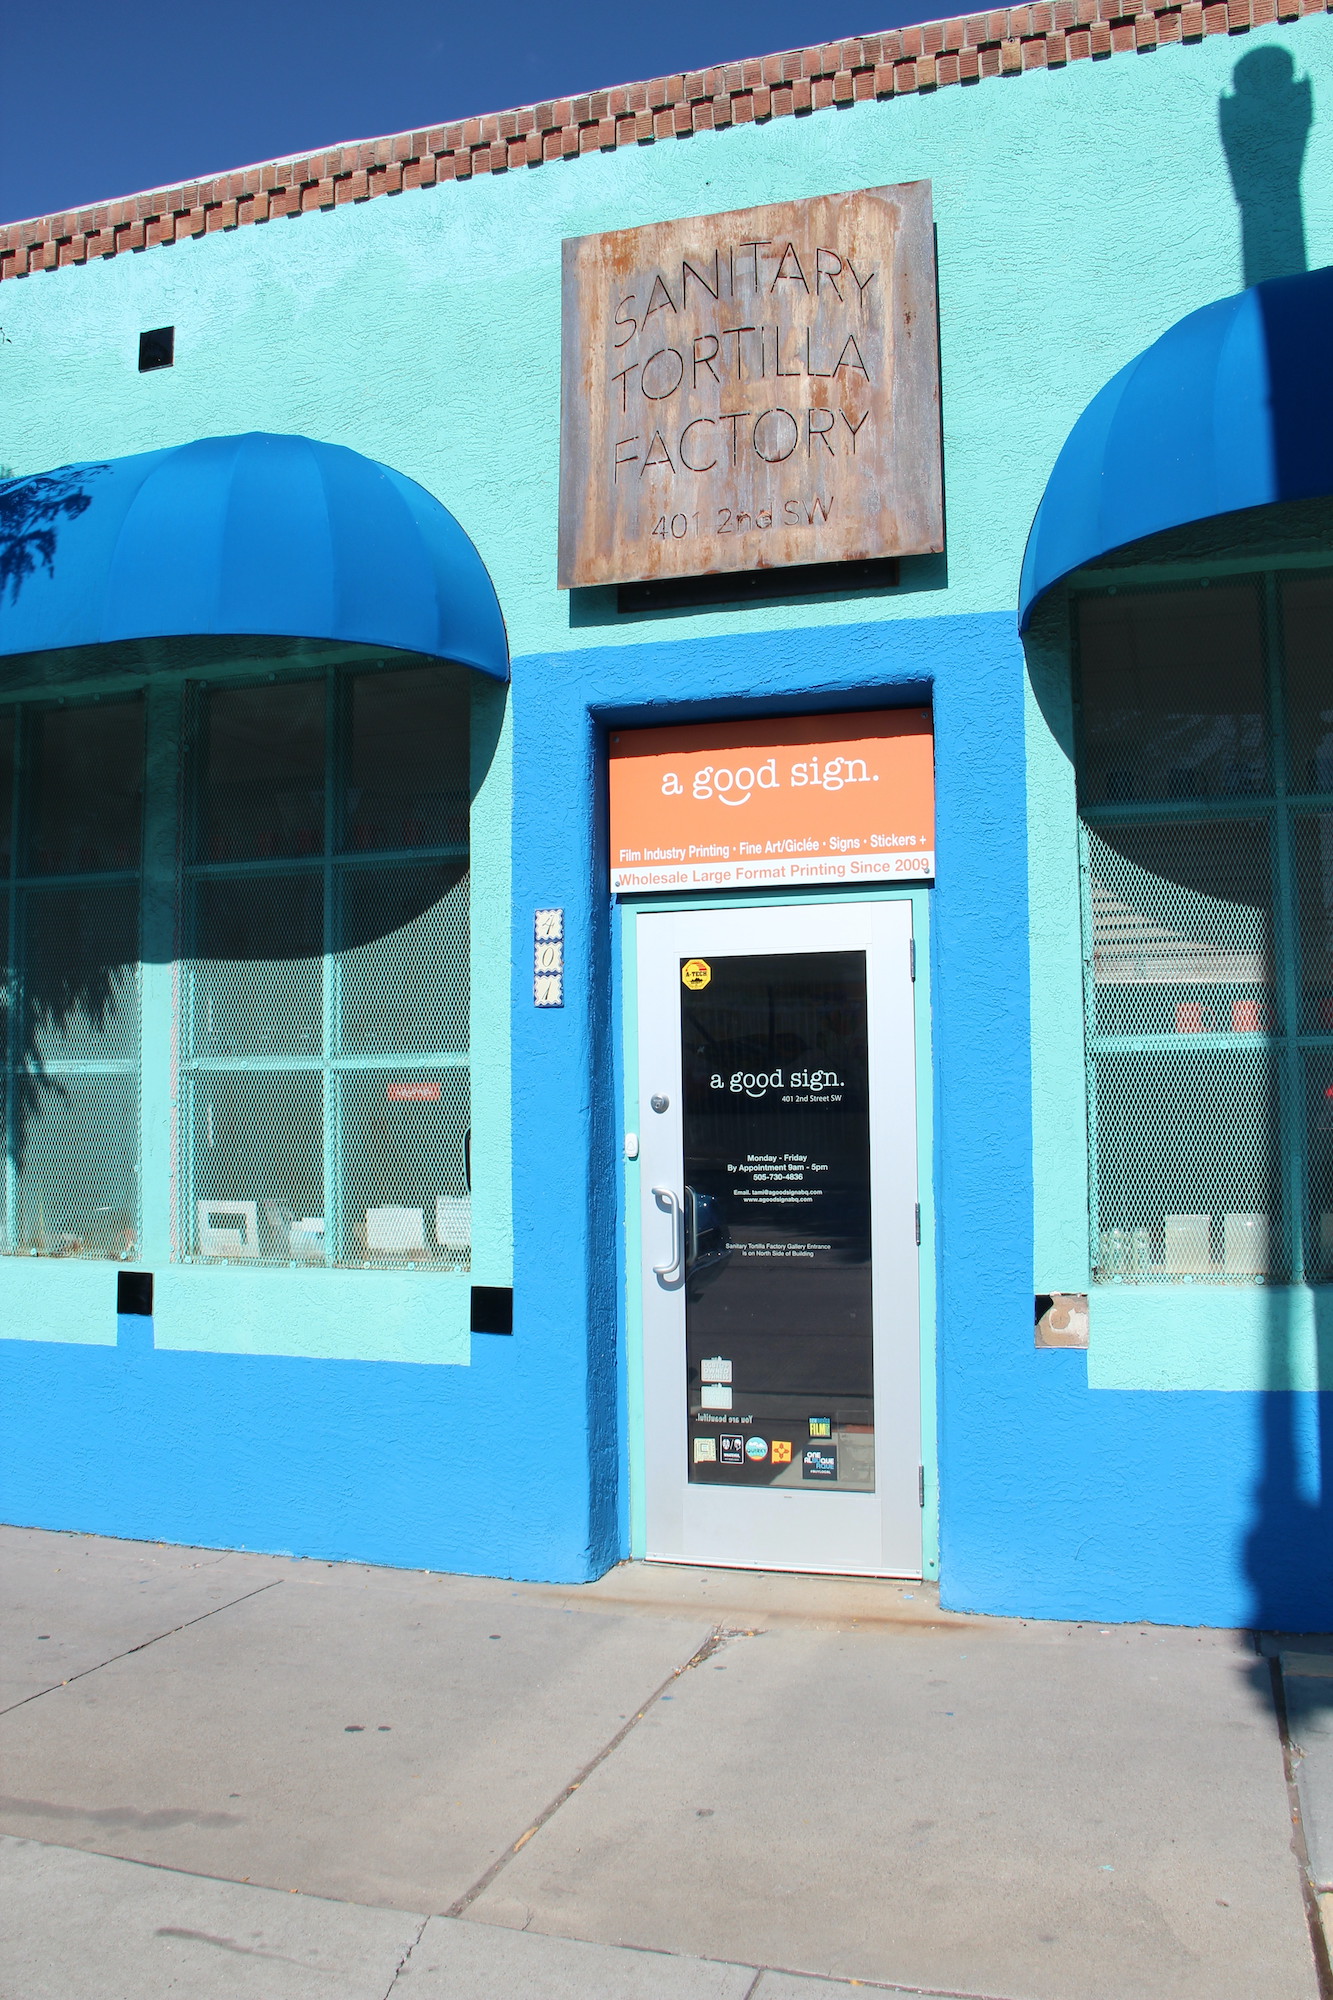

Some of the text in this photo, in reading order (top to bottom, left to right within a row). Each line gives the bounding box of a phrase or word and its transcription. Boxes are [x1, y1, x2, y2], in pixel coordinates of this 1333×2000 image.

[614, 241, 875, 348] SANITARY
[612, 326, 870, 413] TORTILLA
[614, 407, 870, 485] FACTORY
[651, 496, 834, 540] 401 2nd SW
[661, 756, 880, 801] a good sign.
[619, 849, 641, 862] Film
[644, 847, 686, 862] Industry
[688, 844, 730, 859] Printing
[739, 842, 762, 856] Fine
[764, 837, 820, 854] Art/Giclée
[829, 836, 860, 852] Signs
[870, 834, 917, 848] Stickers
[618, 858, 930, 886] Wholesale Large Format Printing Since 2009
[541, 914, 556, 1000] 401
[710, 1068, 845, 1094] a good sign.
[795, 1094, 808, 1102] 2nd
[809, 1094, 830, 1102] Street
[830, 1094, 843, 1102] SW
[727, 1164, 738, 1172] By
[738, 1164, 787, 1172] Appointment
[810, 1164, 829, 1172] 5pm
[746, 1154, 778, 1163] Monday
[784, 1154, 808, 1163] Friday
[752, 1173, 804, 1181] 505-730-4836
[766, 1242, 786, 1250] Factory
[810, 1423, 826, 1436] FILM
